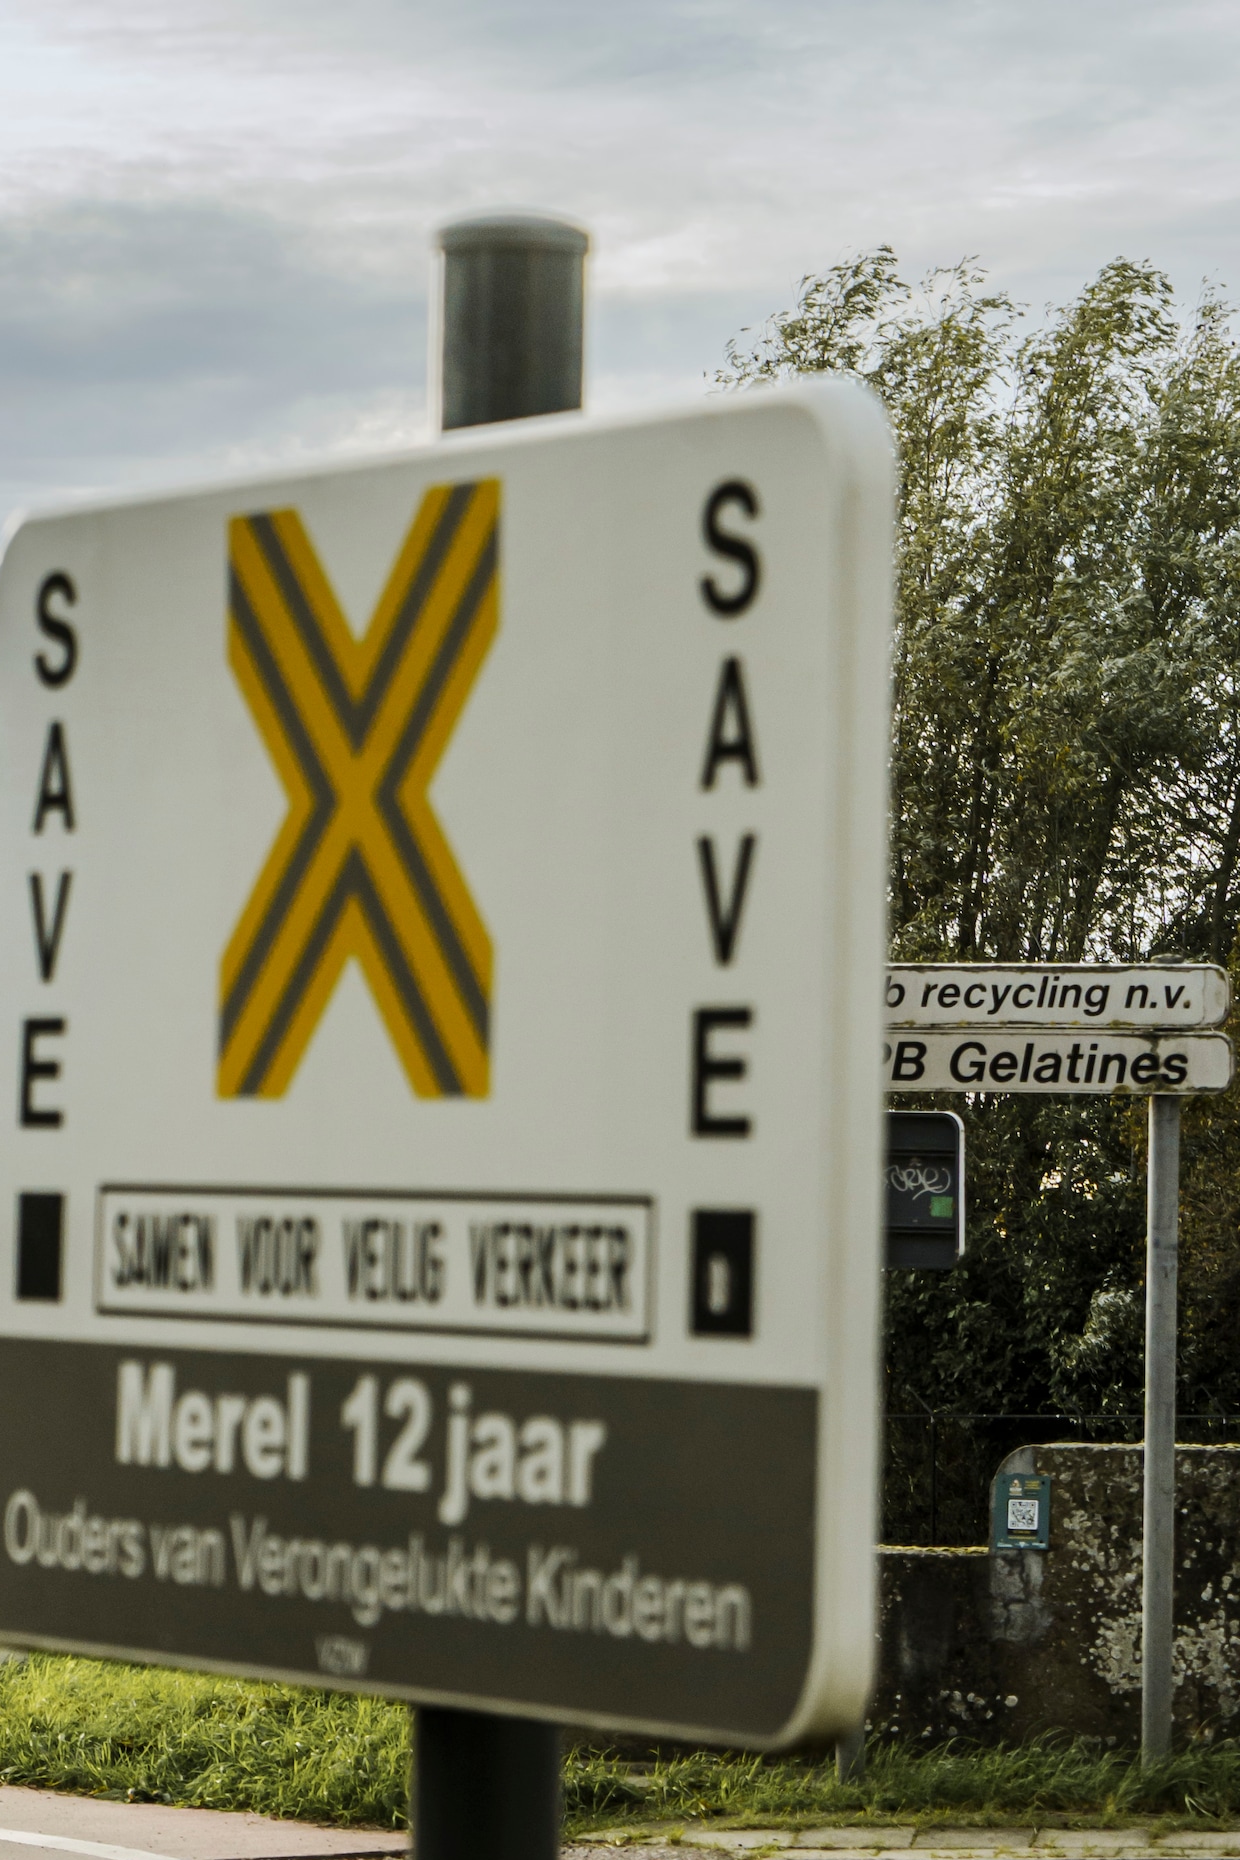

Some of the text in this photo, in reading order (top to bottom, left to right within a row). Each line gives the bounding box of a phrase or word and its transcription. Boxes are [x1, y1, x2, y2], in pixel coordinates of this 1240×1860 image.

[19, 571, 79, 1128] SAVE
[690, 478, 762, 1139] SAVE
[920, 975, 1110, 1016] recycling
[1124, 983, 1191, 1010] n.v.
[949, 1041, 1189, 1085] Gelatines
[113, 1213, 633, 1311] SAMEN VOOR VEILIG VERKEER
[116, 1361, 310, 1481] Merel
[3, 1489, 754, 1653] Ouders van Verongelukte Kinderen
